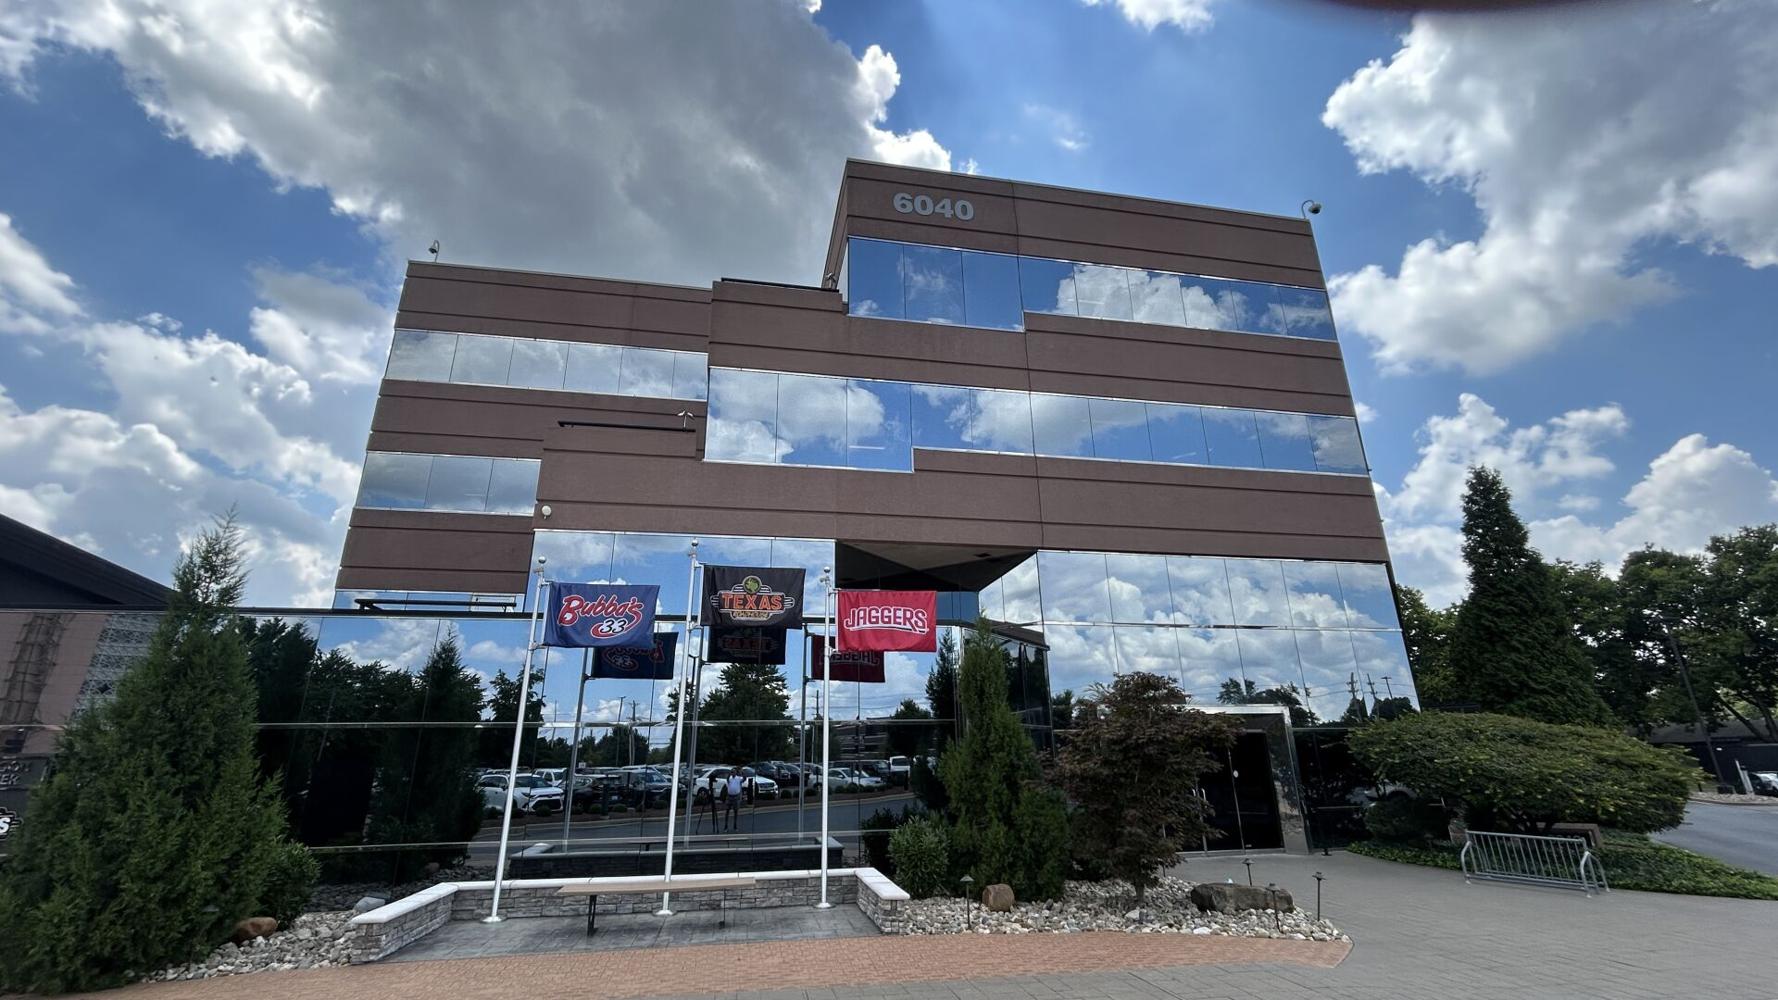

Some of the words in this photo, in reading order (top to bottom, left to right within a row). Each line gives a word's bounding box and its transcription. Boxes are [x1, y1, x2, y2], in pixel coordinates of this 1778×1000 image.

[893, 192, 975, 220] 6040
[557, 594, 644, 627] Bubba's
[721, 592, 782, 610] TEXAS
[599, 618, 629, 634] 33
[844, 605, 929, 634] JAGGERS
